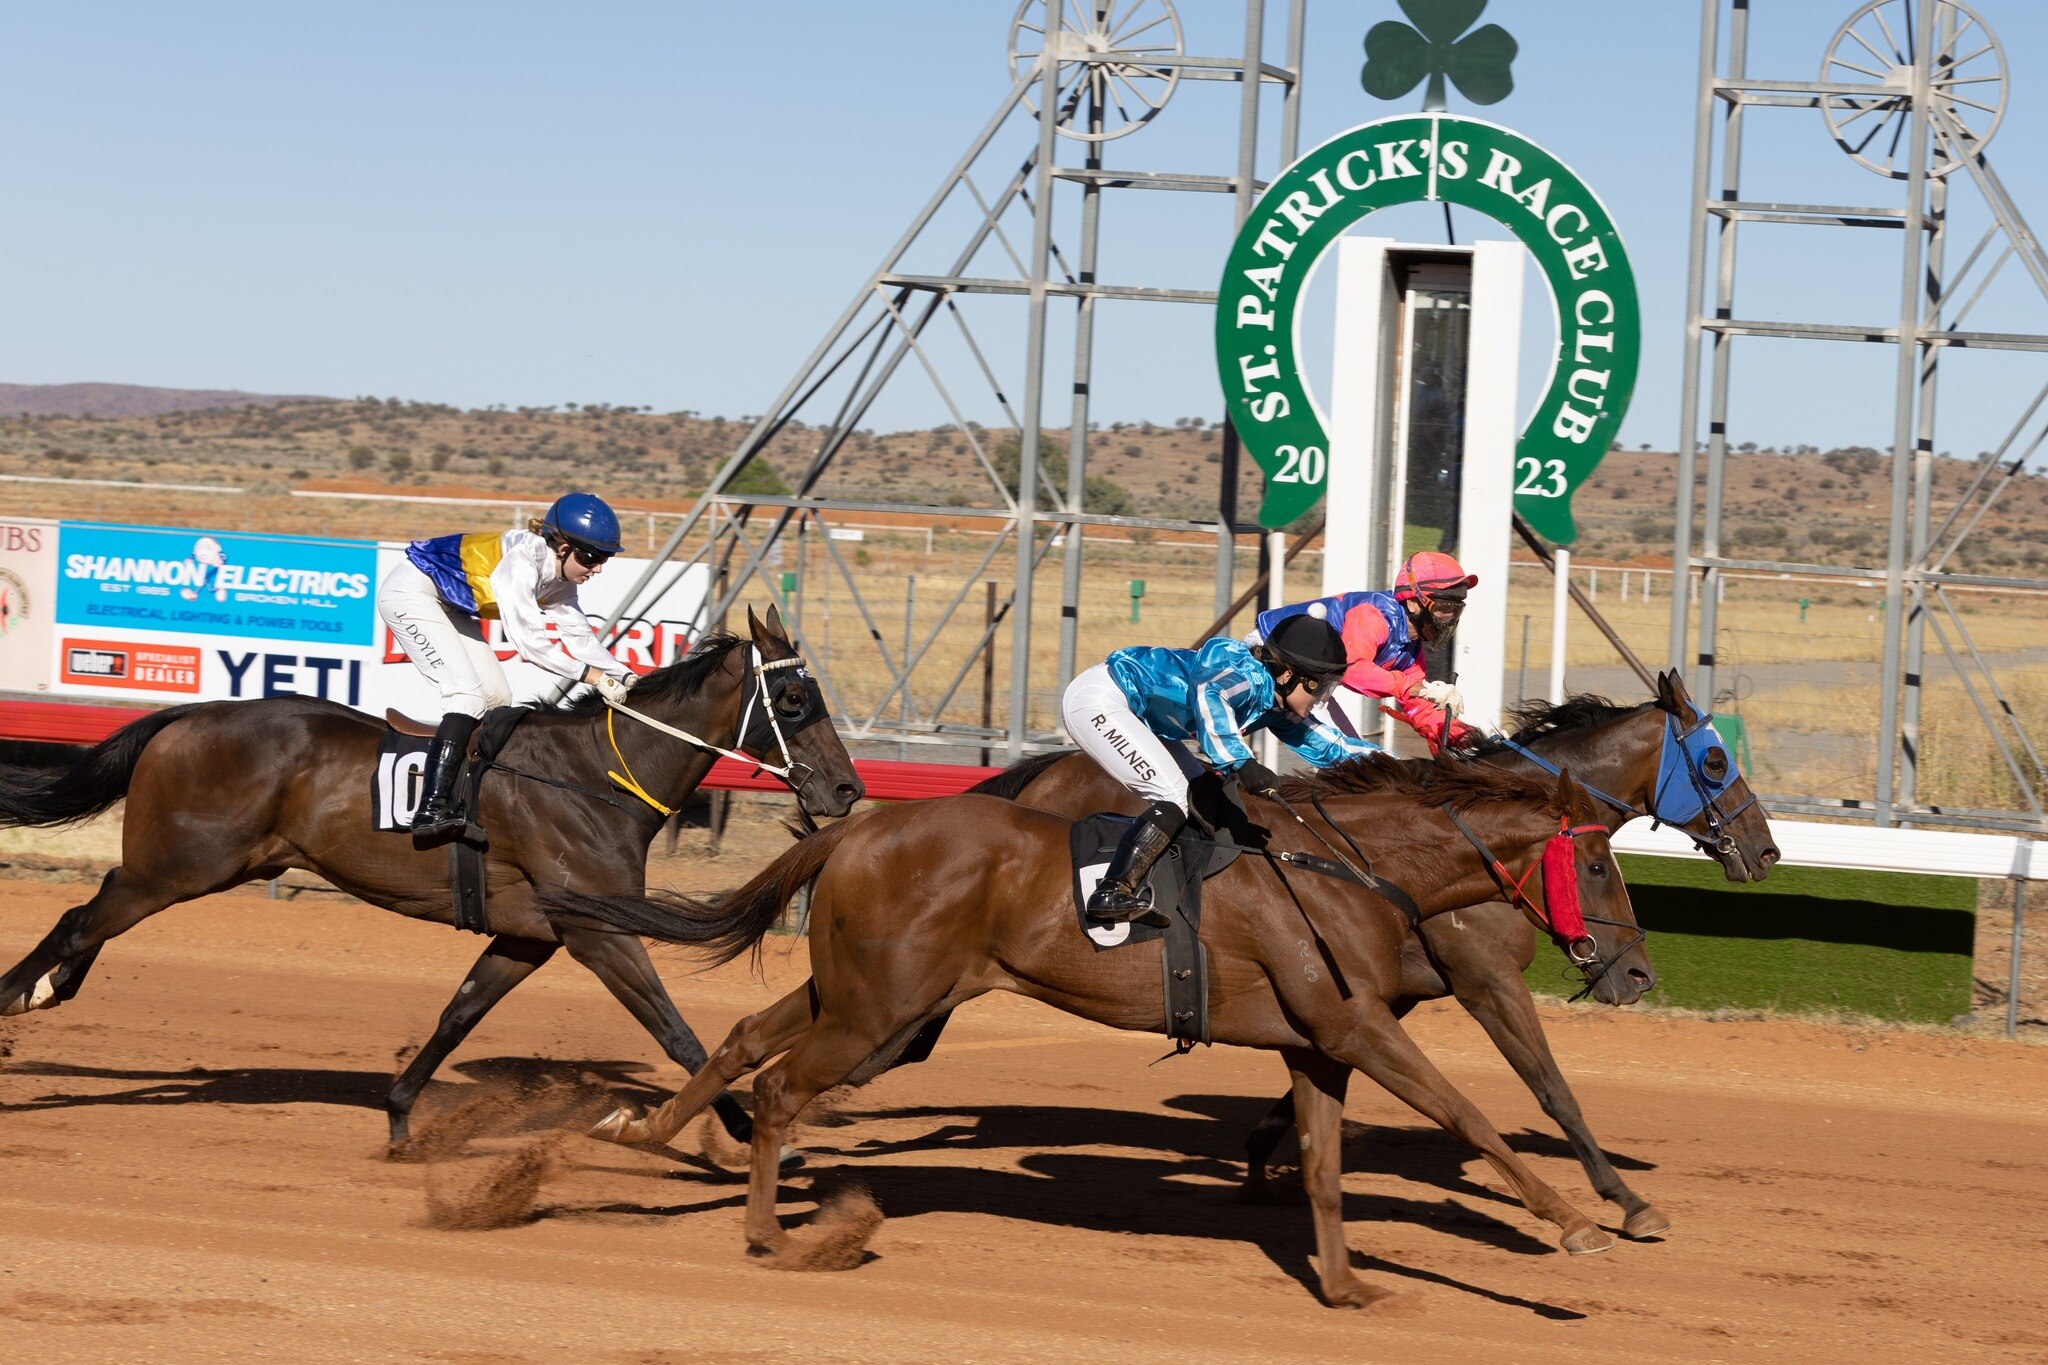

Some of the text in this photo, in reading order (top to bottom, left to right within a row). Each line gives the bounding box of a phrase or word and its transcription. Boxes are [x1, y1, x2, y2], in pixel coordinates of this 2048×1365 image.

[1236, 138, 1615, 445] ST. PATRICK'S RACE CLUB
[1272, 445, 1326, 485] 20
[1514, 457, 1568, 498] 23
[64, 553, 370, 599] SHANNON ELECTRICS
[100, 582, 131, 593] EST
[235, 592, 298, 605] BROKEN
[171, 611, 230, 625] LIGHTING
[234, 614, 243, 625] &
[248, 615, 296, 629] POWER
[300, 619, 343, 633] TOOLS
[394, 611, 444, 669] J. DOYLE
[134, 667, 196, 685] DEALER
[135, 651, 196, 665] SPECIALIST
[216, 650, 361, 706] YETI
[1091, 714, 1156, 781] R. MILNES
[378, 751, 428, 829] 10
